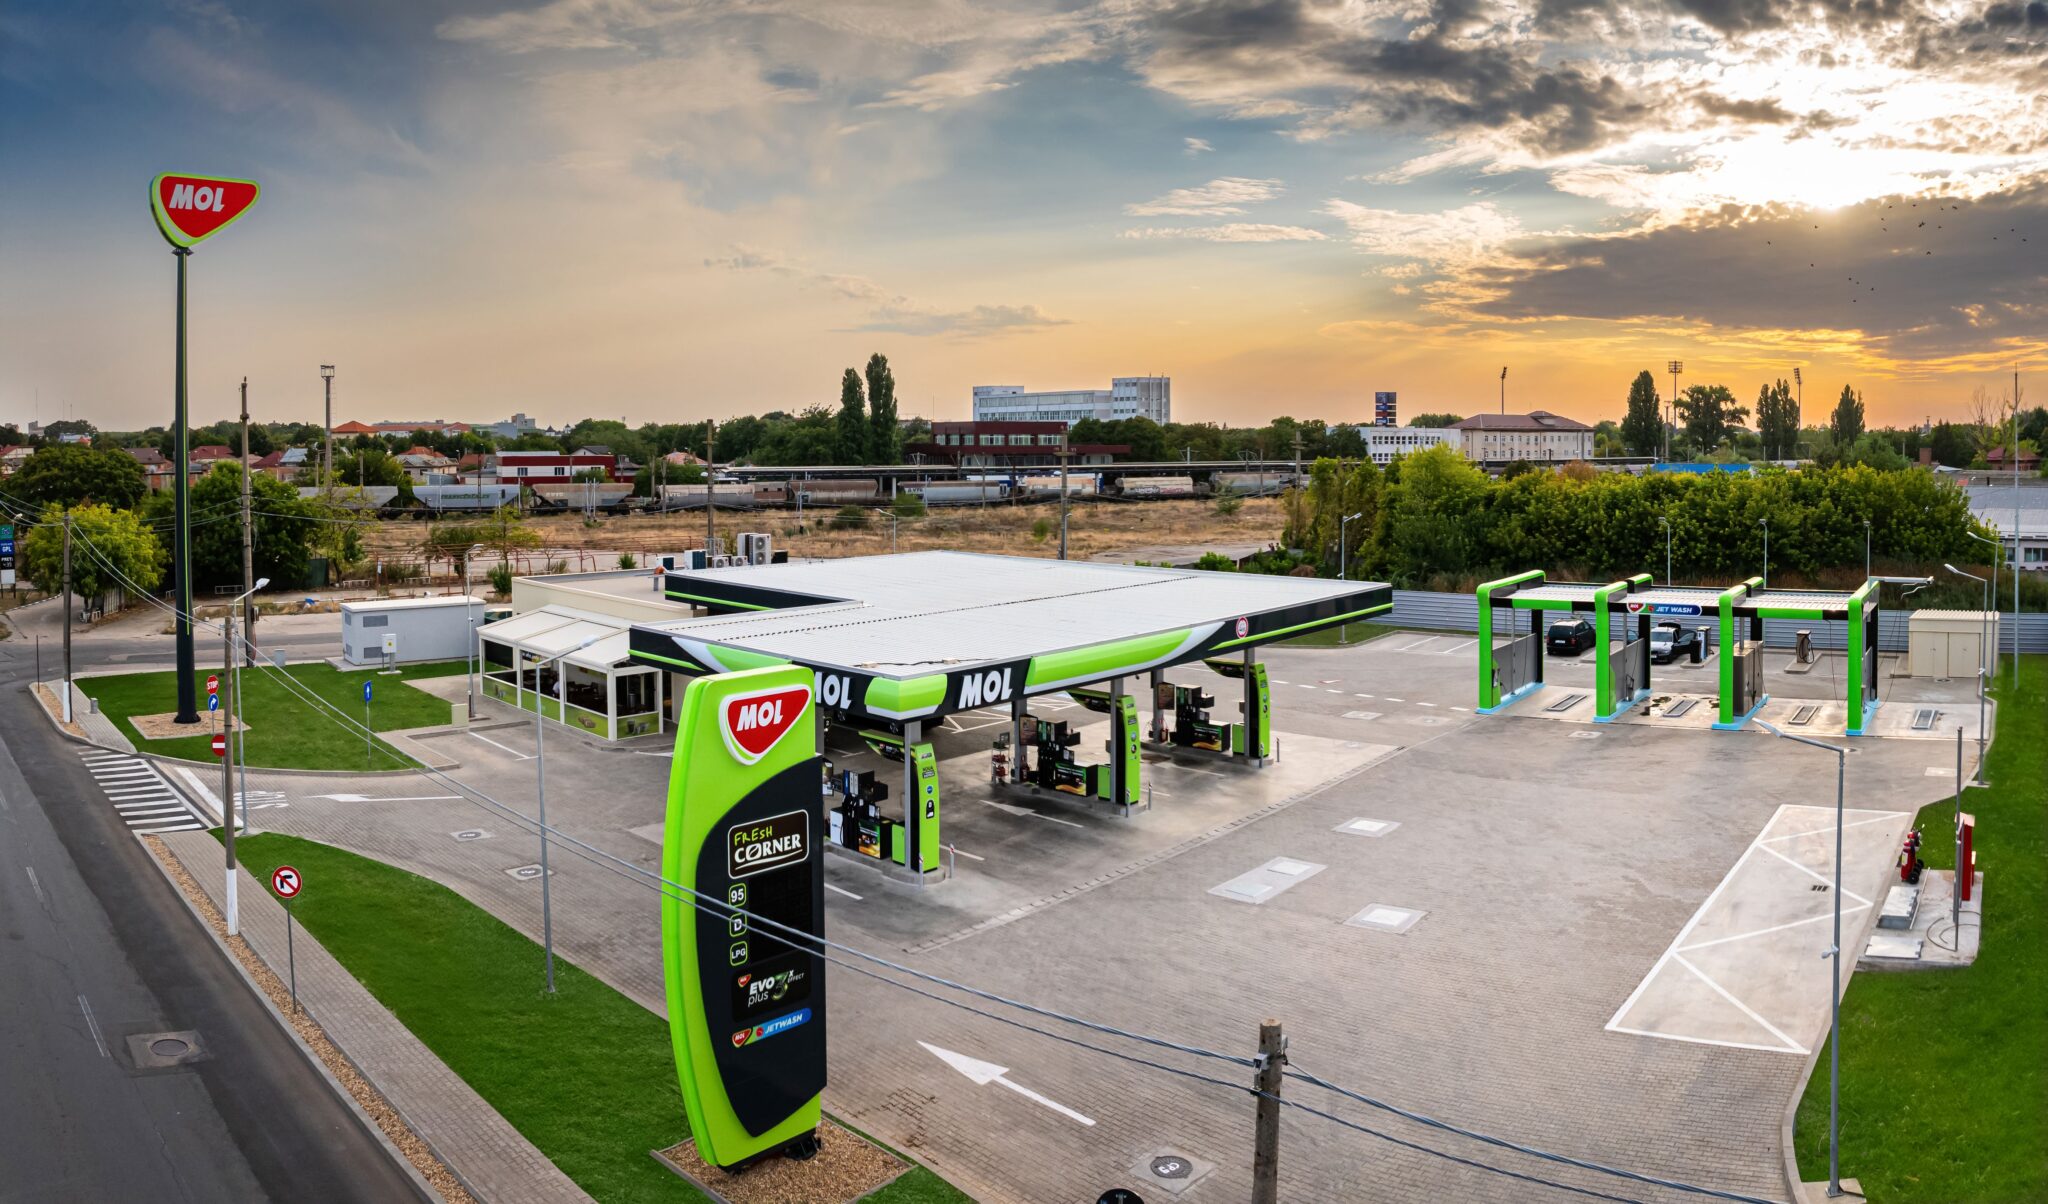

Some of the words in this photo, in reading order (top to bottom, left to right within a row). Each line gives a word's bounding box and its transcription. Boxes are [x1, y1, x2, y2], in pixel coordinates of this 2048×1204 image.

[169, 183, 225, 213] MOL
[207, 680, 219, 690] STOP
[958, 667, 1013, 709] MOL
[736, 699, 783, 731] MOL
[734, 825, 773, 846] FRESH
[731, 888, 744, 903] 95
[733, 918, 743, 932] D
[731, 947, 746, 960] LPG
[749, 976, 775, 995] EVO
[748, 991, 769, 1008] plus
[765, 1013, 803, 1034] JETWASH
